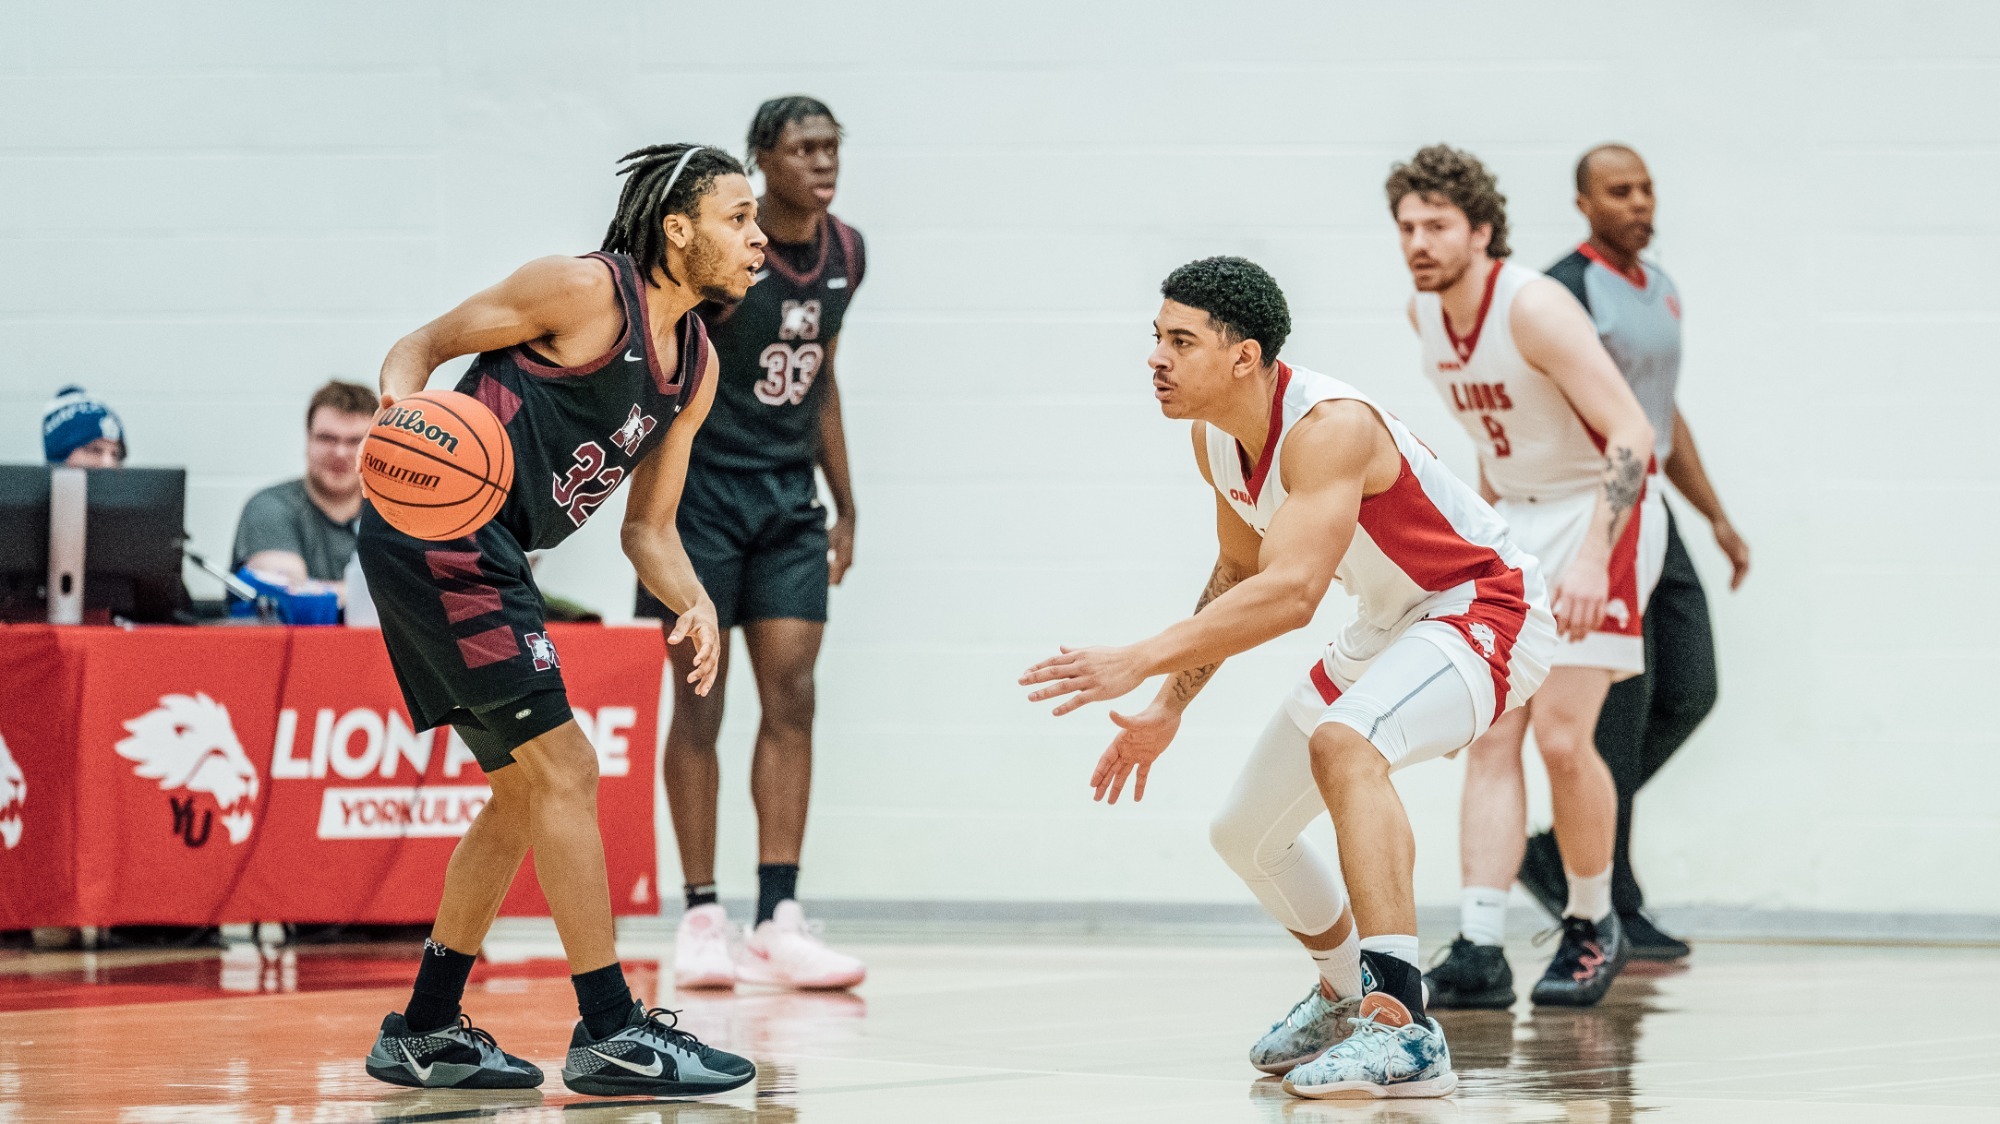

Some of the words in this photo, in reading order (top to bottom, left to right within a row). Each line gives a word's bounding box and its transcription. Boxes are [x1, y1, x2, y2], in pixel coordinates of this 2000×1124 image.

[754, 342, 824, 406] 33
[377, 406, 459, 455] Wilson
[364, 452, 441, 488] EVOLUTION
[552, 441, 625, 528] 32
[270, 707, 437, 779] LION
[170, 796, 213, 849] YU
